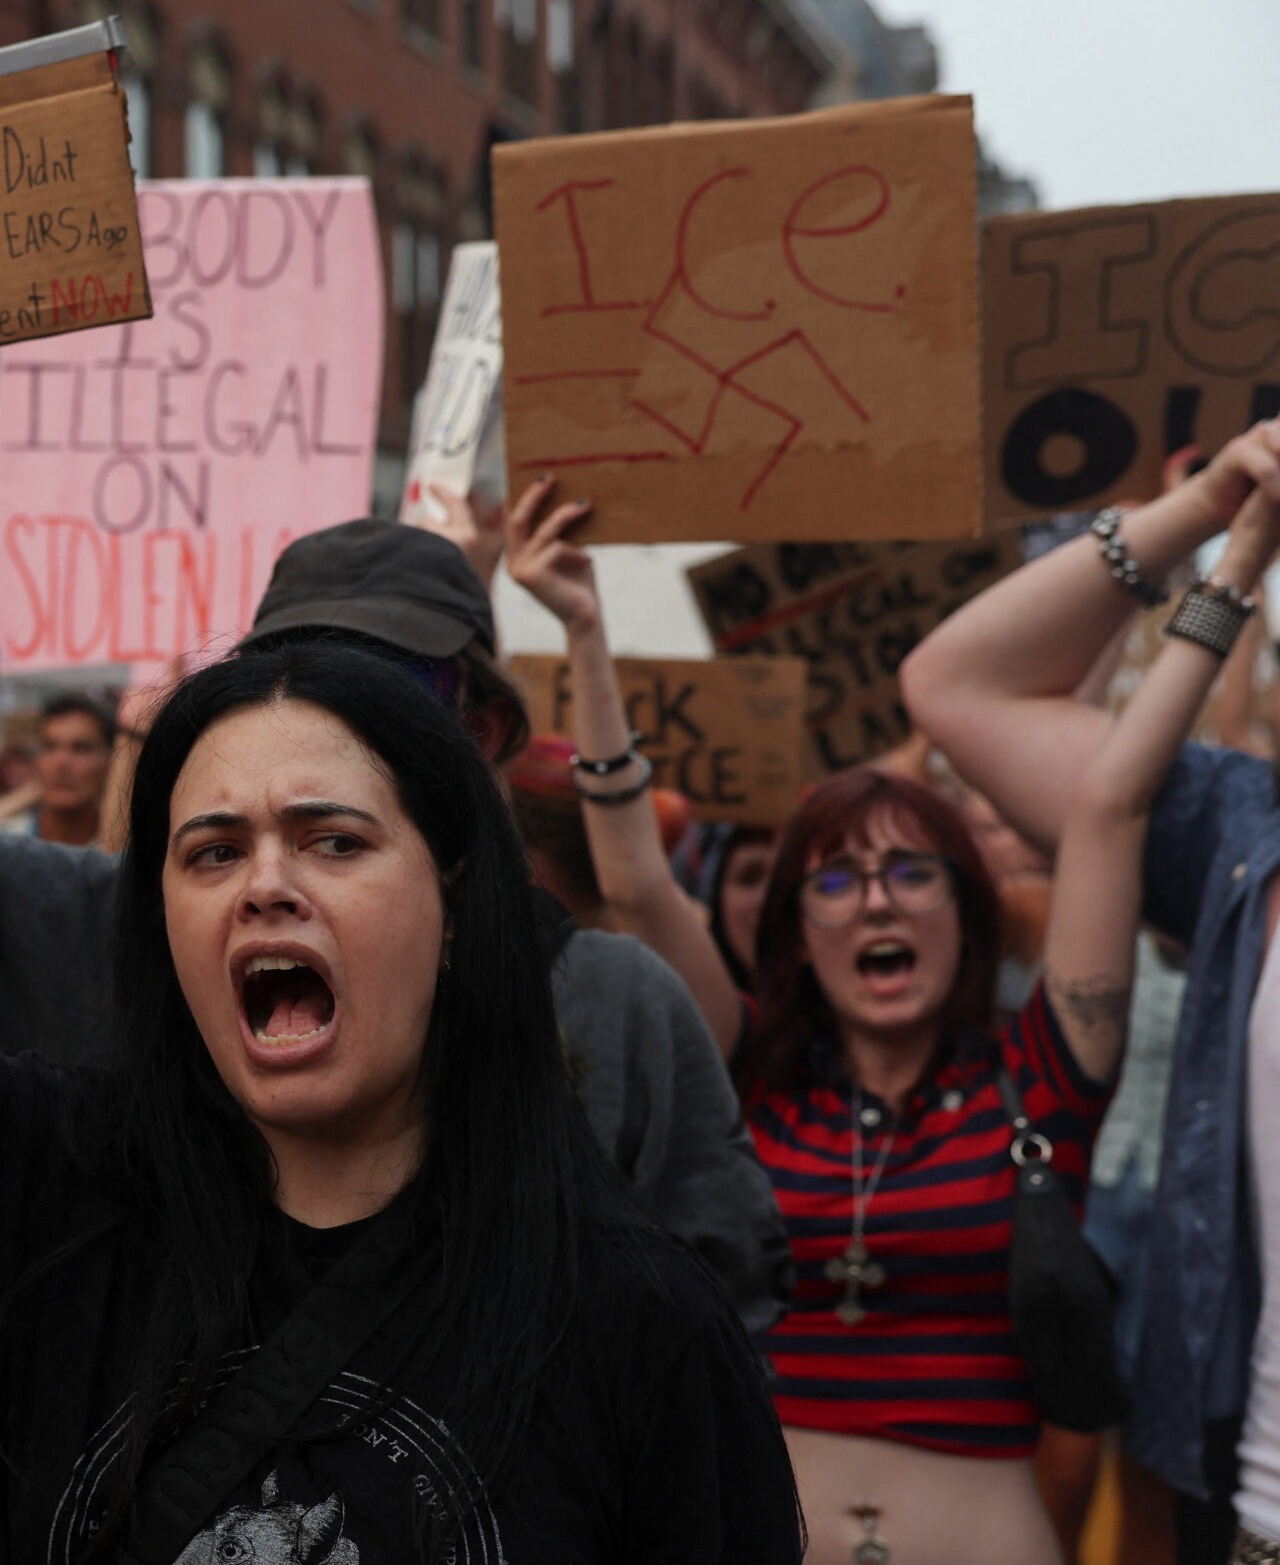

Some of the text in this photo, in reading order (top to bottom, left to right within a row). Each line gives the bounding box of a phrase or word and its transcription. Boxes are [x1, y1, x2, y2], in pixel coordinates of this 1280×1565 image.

[3, 125, 78, 194] Didnt
[137, 187, 341, 291] BODY
[49, 272, 135, 328] NOW
[2, 358, 364, 464] ILLEGAL
[92, 454, 211, 535] ON
[3, 513, 217, 662] STOLEN
[553, 662, 708, 747] FCK
